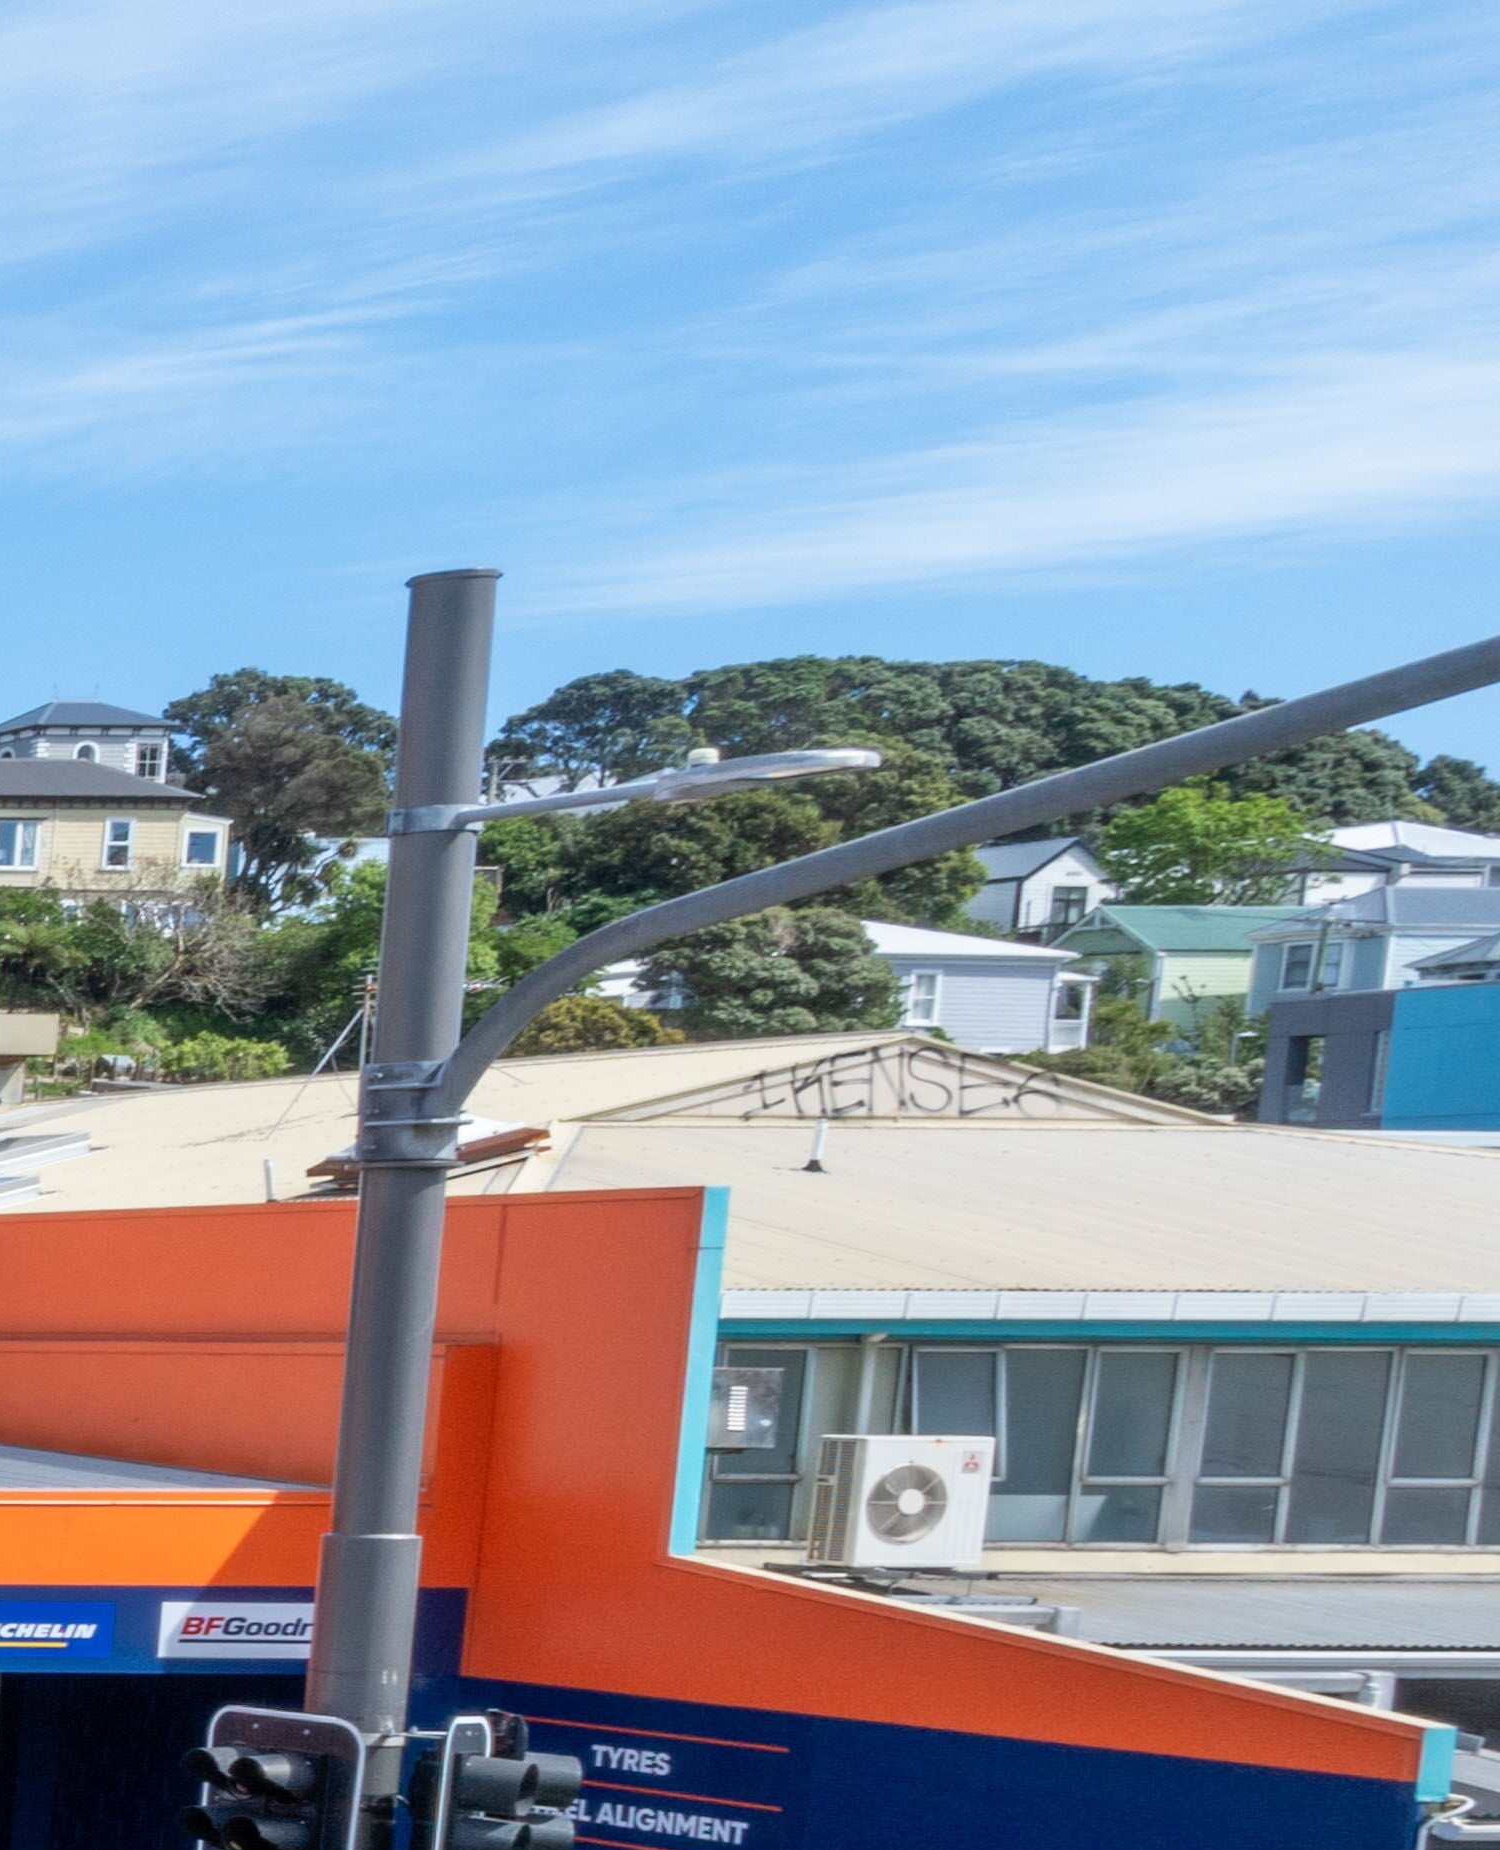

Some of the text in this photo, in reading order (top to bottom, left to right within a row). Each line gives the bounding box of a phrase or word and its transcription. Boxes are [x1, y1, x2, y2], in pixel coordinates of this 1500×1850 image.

[180, 1616, 314, 1637] BFGoodr
[591, 1744, 672, 1776] TYRES
[595, 1802, 750, 1845] ALIGNMENT
